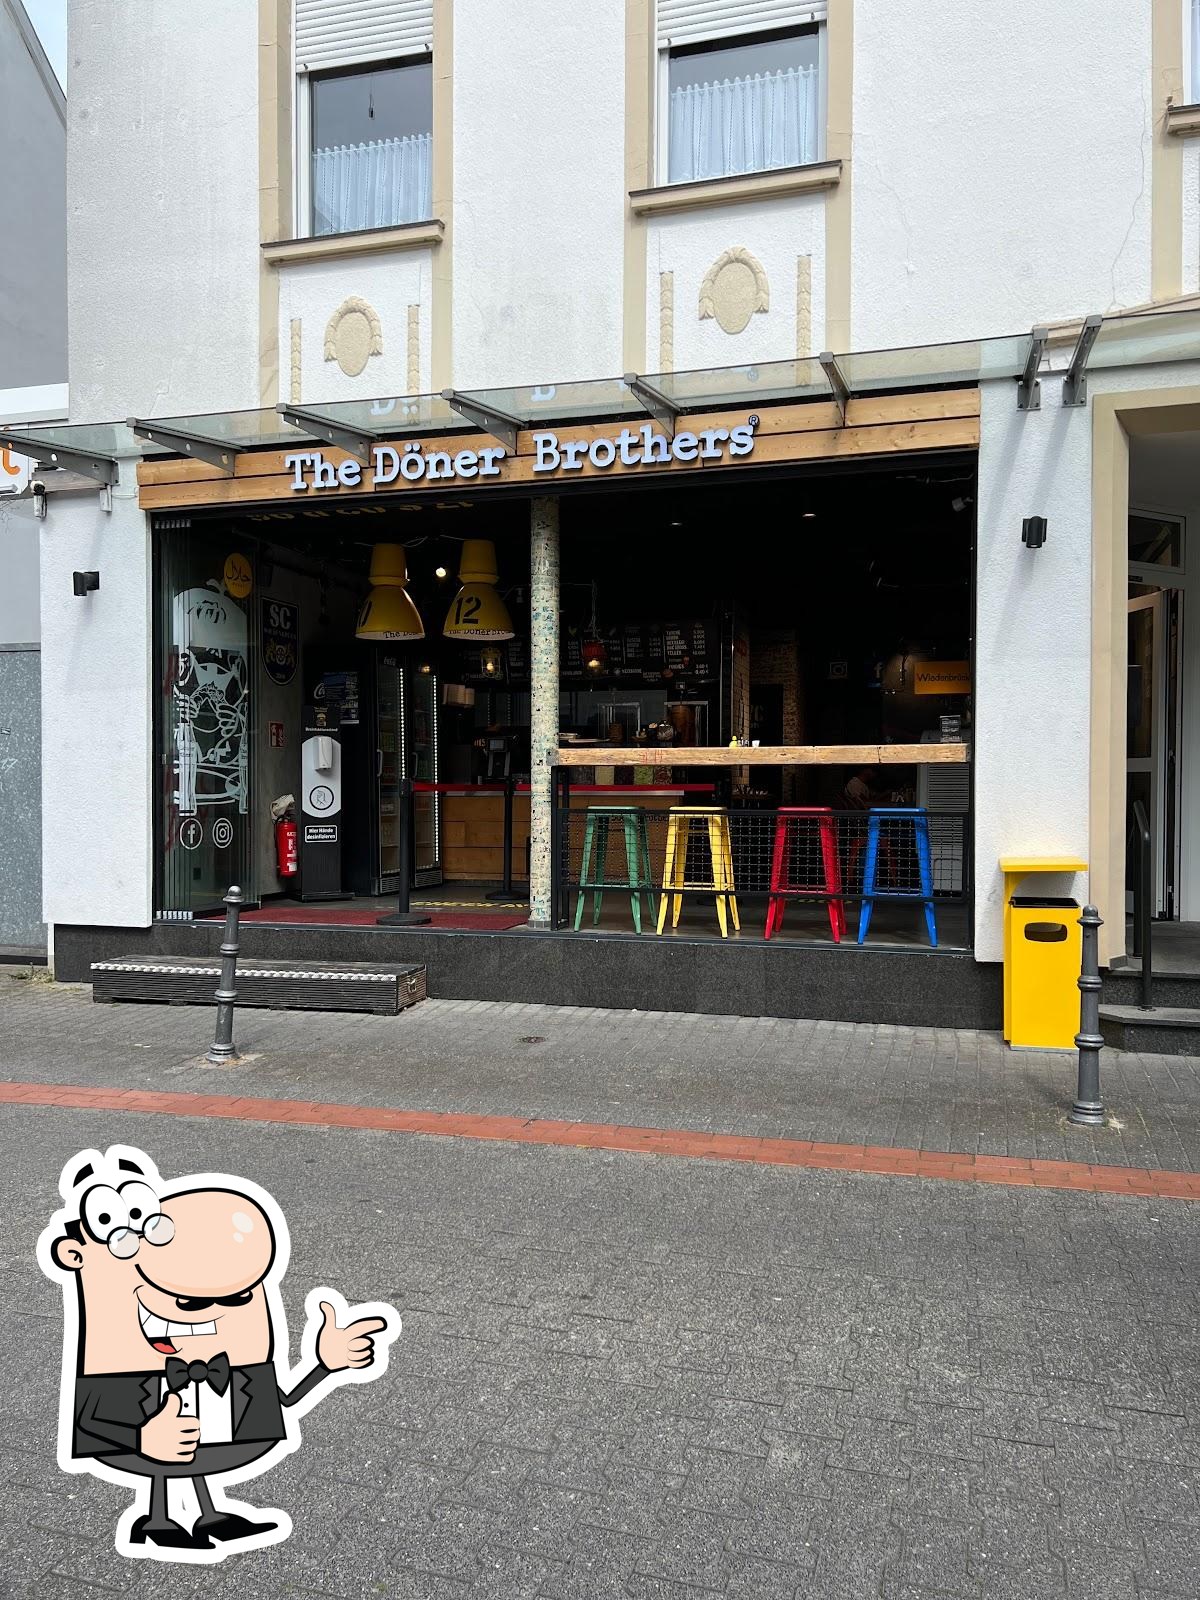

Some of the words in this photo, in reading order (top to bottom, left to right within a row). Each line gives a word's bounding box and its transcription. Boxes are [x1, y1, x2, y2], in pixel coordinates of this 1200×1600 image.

[285, 453, 362, 490] The
[372, 442, 505, 484] Döner
[269, 604, 291, 631] SC
[455, 597, 482, 626] 12
